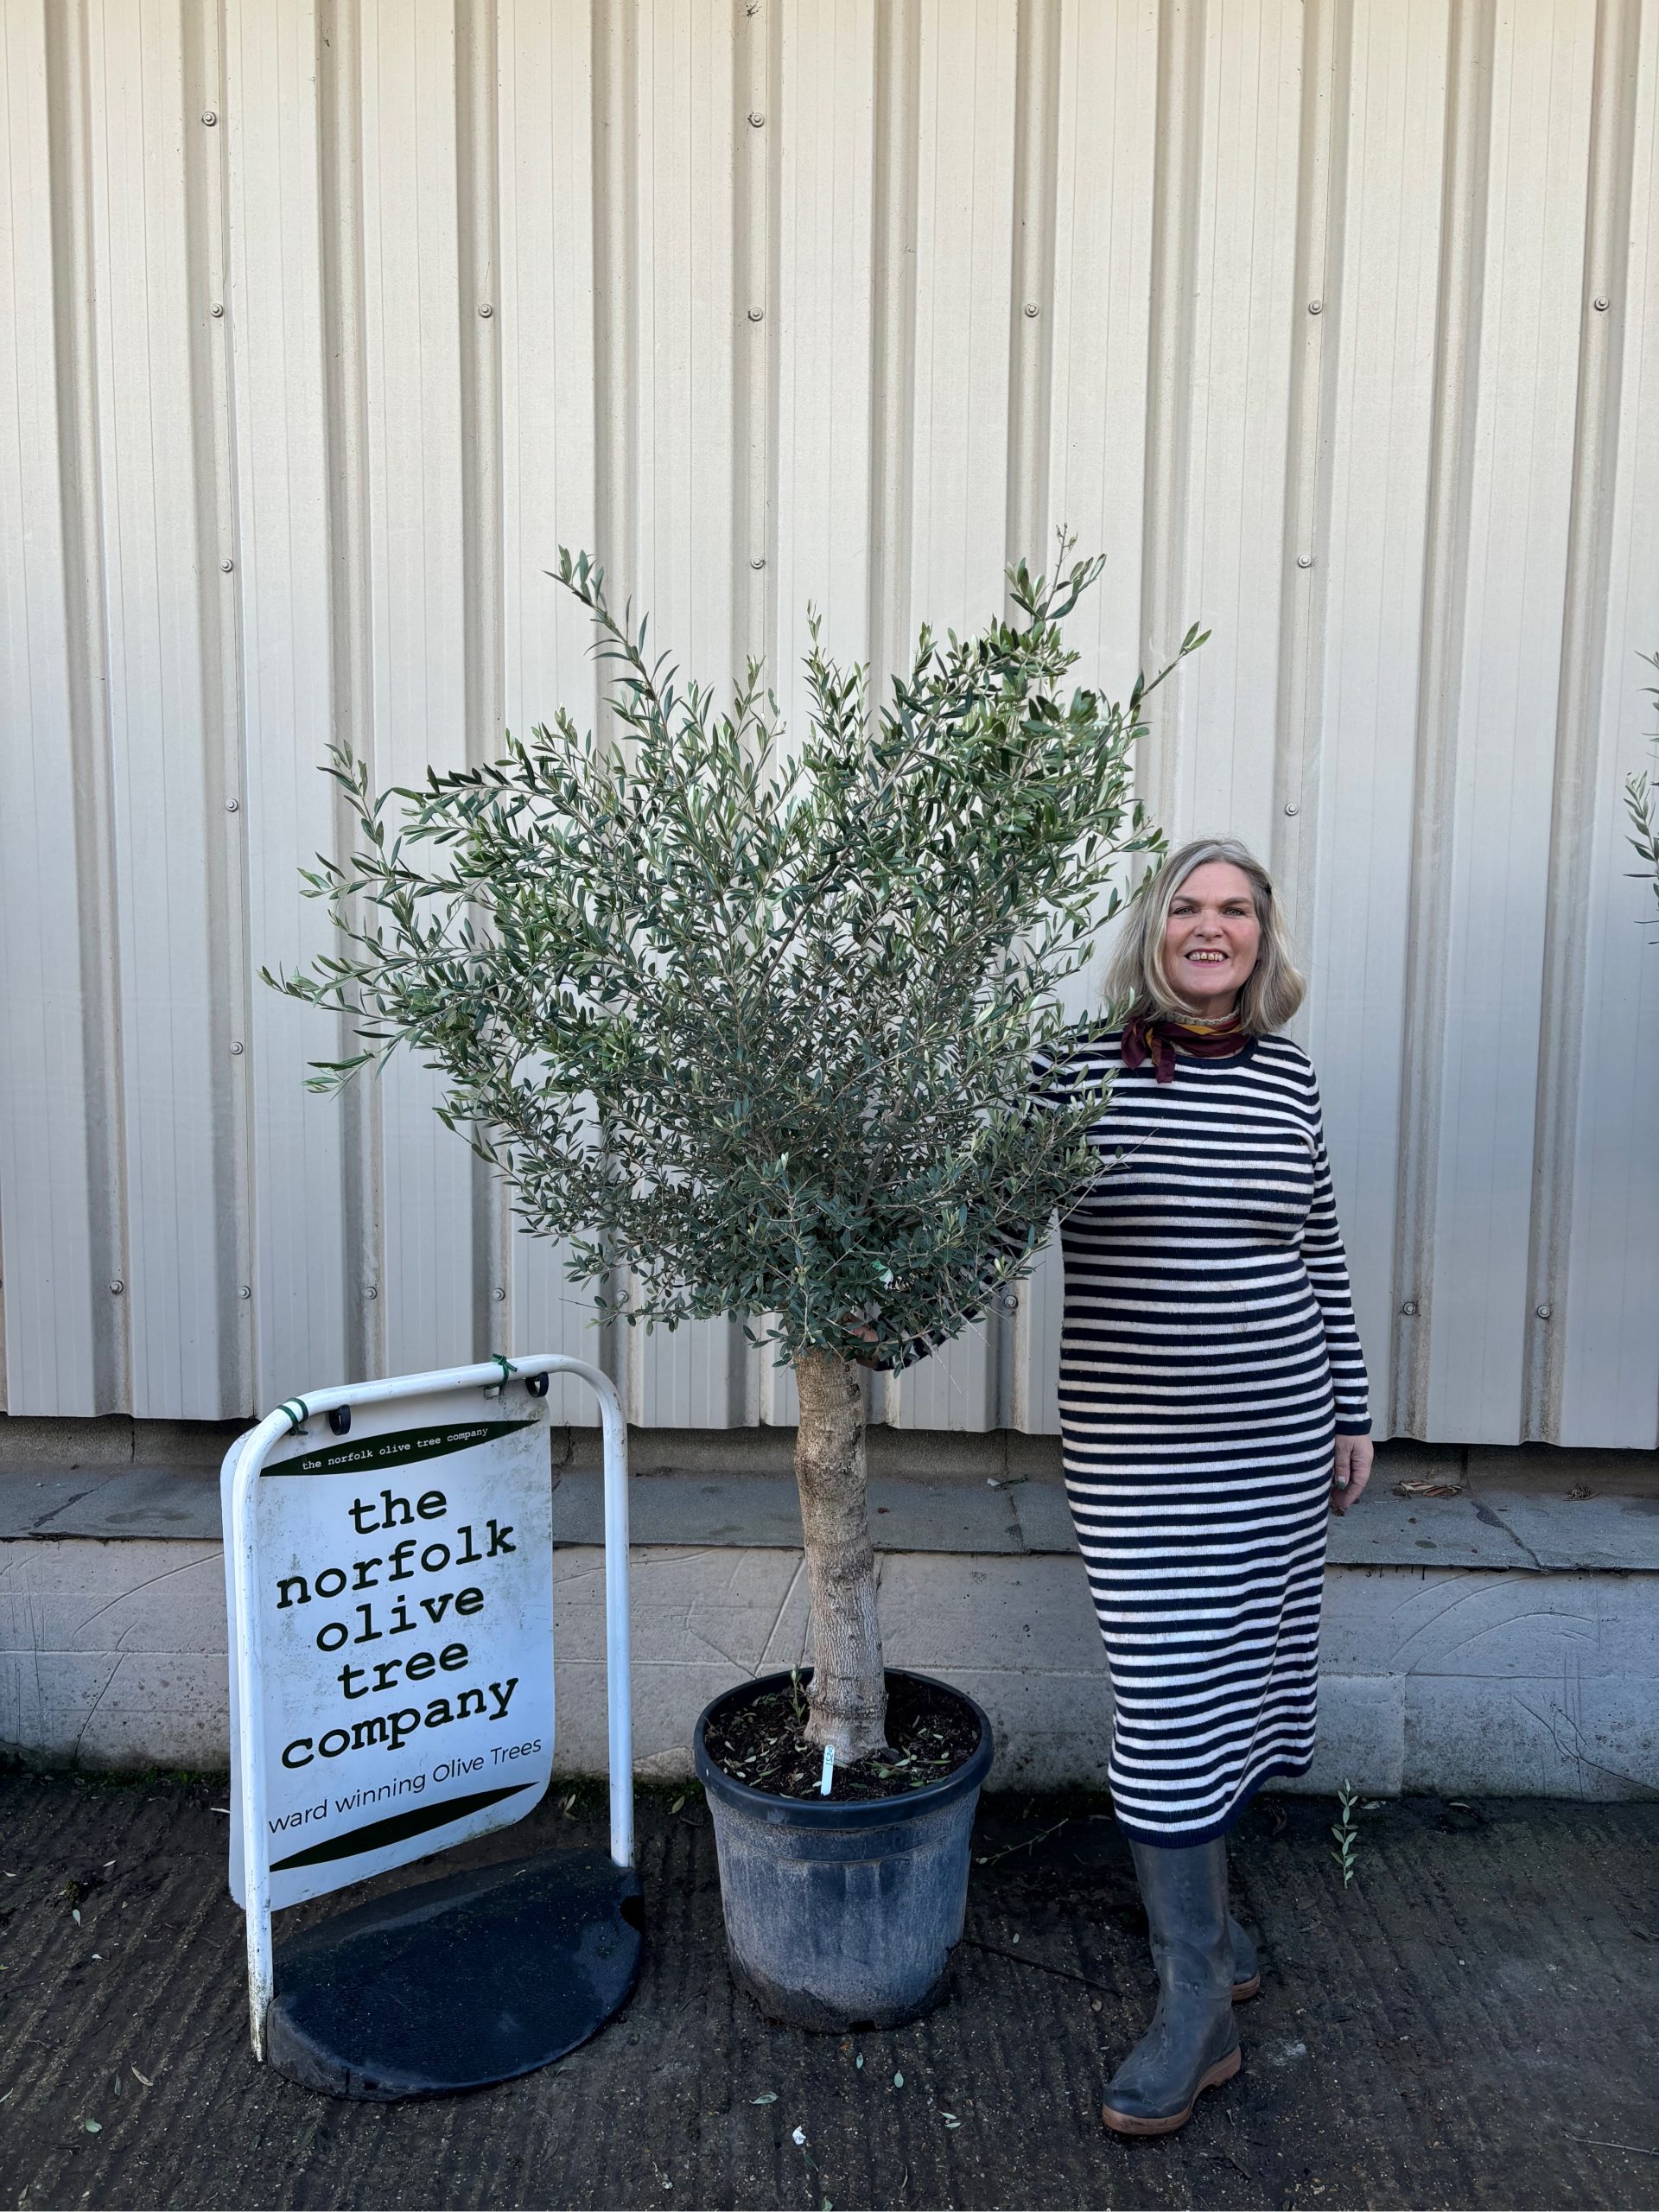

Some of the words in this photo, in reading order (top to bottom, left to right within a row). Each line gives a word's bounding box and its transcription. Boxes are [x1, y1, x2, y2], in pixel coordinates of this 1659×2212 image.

[302, 1458, 321, 1470] the
[327, 1449, 373, 1466] norfolk
[379, 1442, 411, 1456] olive
[416, 1437, 442, 1448] tree
[447, 1427, 488, 1443] company
[347, 1489, 448, 1535] the
[276, 1519, 517, 1610] norfolk
[316, 1586, 485, 1652] olive
[337, 1643, 469, 1700] tree
[281, 1677, 519, 1770] company
[268, 1798, 327, 1834] ward
[334, 1773, 426, 1813] winning
[432, 1756, 485, 1783] Olive
[490, 1738, 542, 1765] Trees
